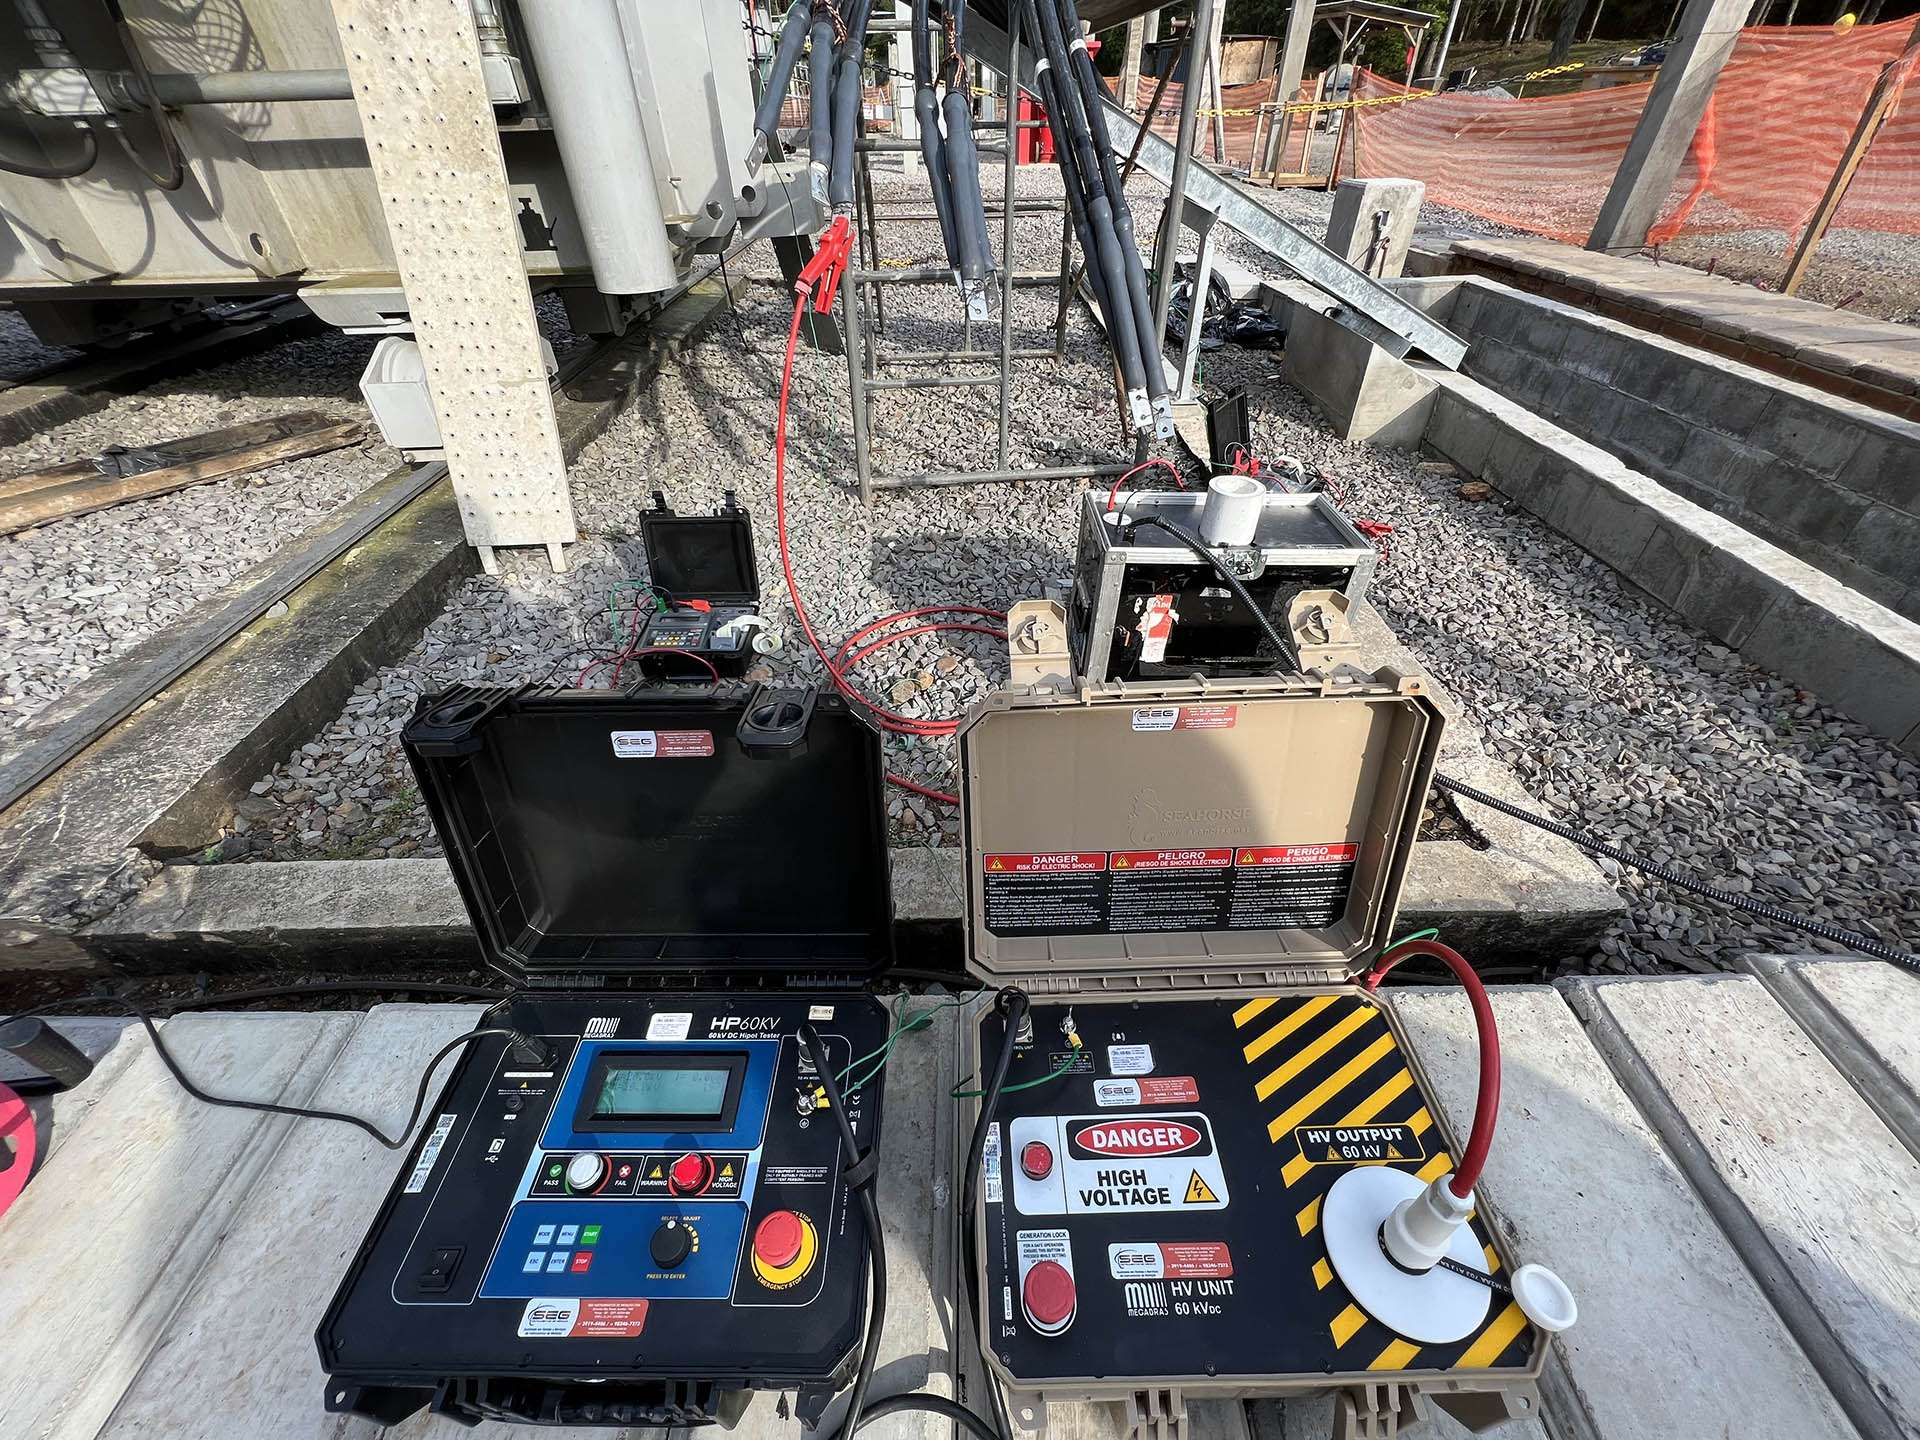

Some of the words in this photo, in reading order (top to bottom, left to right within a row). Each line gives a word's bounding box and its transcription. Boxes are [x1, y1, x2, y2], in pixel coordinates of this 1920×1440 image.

[1158, 852, 1206, 860] PELIGRO
[1287, 847, 1328, 856] PERIGO
[1032, 856, 1078, 864] DANGER
[1092, 1128, 1184, 1149] DANGER
[1307, 1130, 1330, 1143] HV
[1336, 1128, 1402, 1142] OUTPUT
[1342, 1146, 1360, 1158] 60
[1362, 1144, 1380, 1158] kV
[1097, 1170, 1148, 1187] HIGH
[1080, 1188, 1172, 1207] VOLTAGE
[1119, 1254, 1156, 1263] SEG
[757, 1276, 787, 1290] EMERGENCY
[790, 1276, 802, 1288] STOP
[1170, 1281, 1192, 1296] HV
[1197, 1280, 1234, 1296] UNIT
[532, 1310, 571, 1320] SEG
[1174, 1302, 1190, 1315] 60
